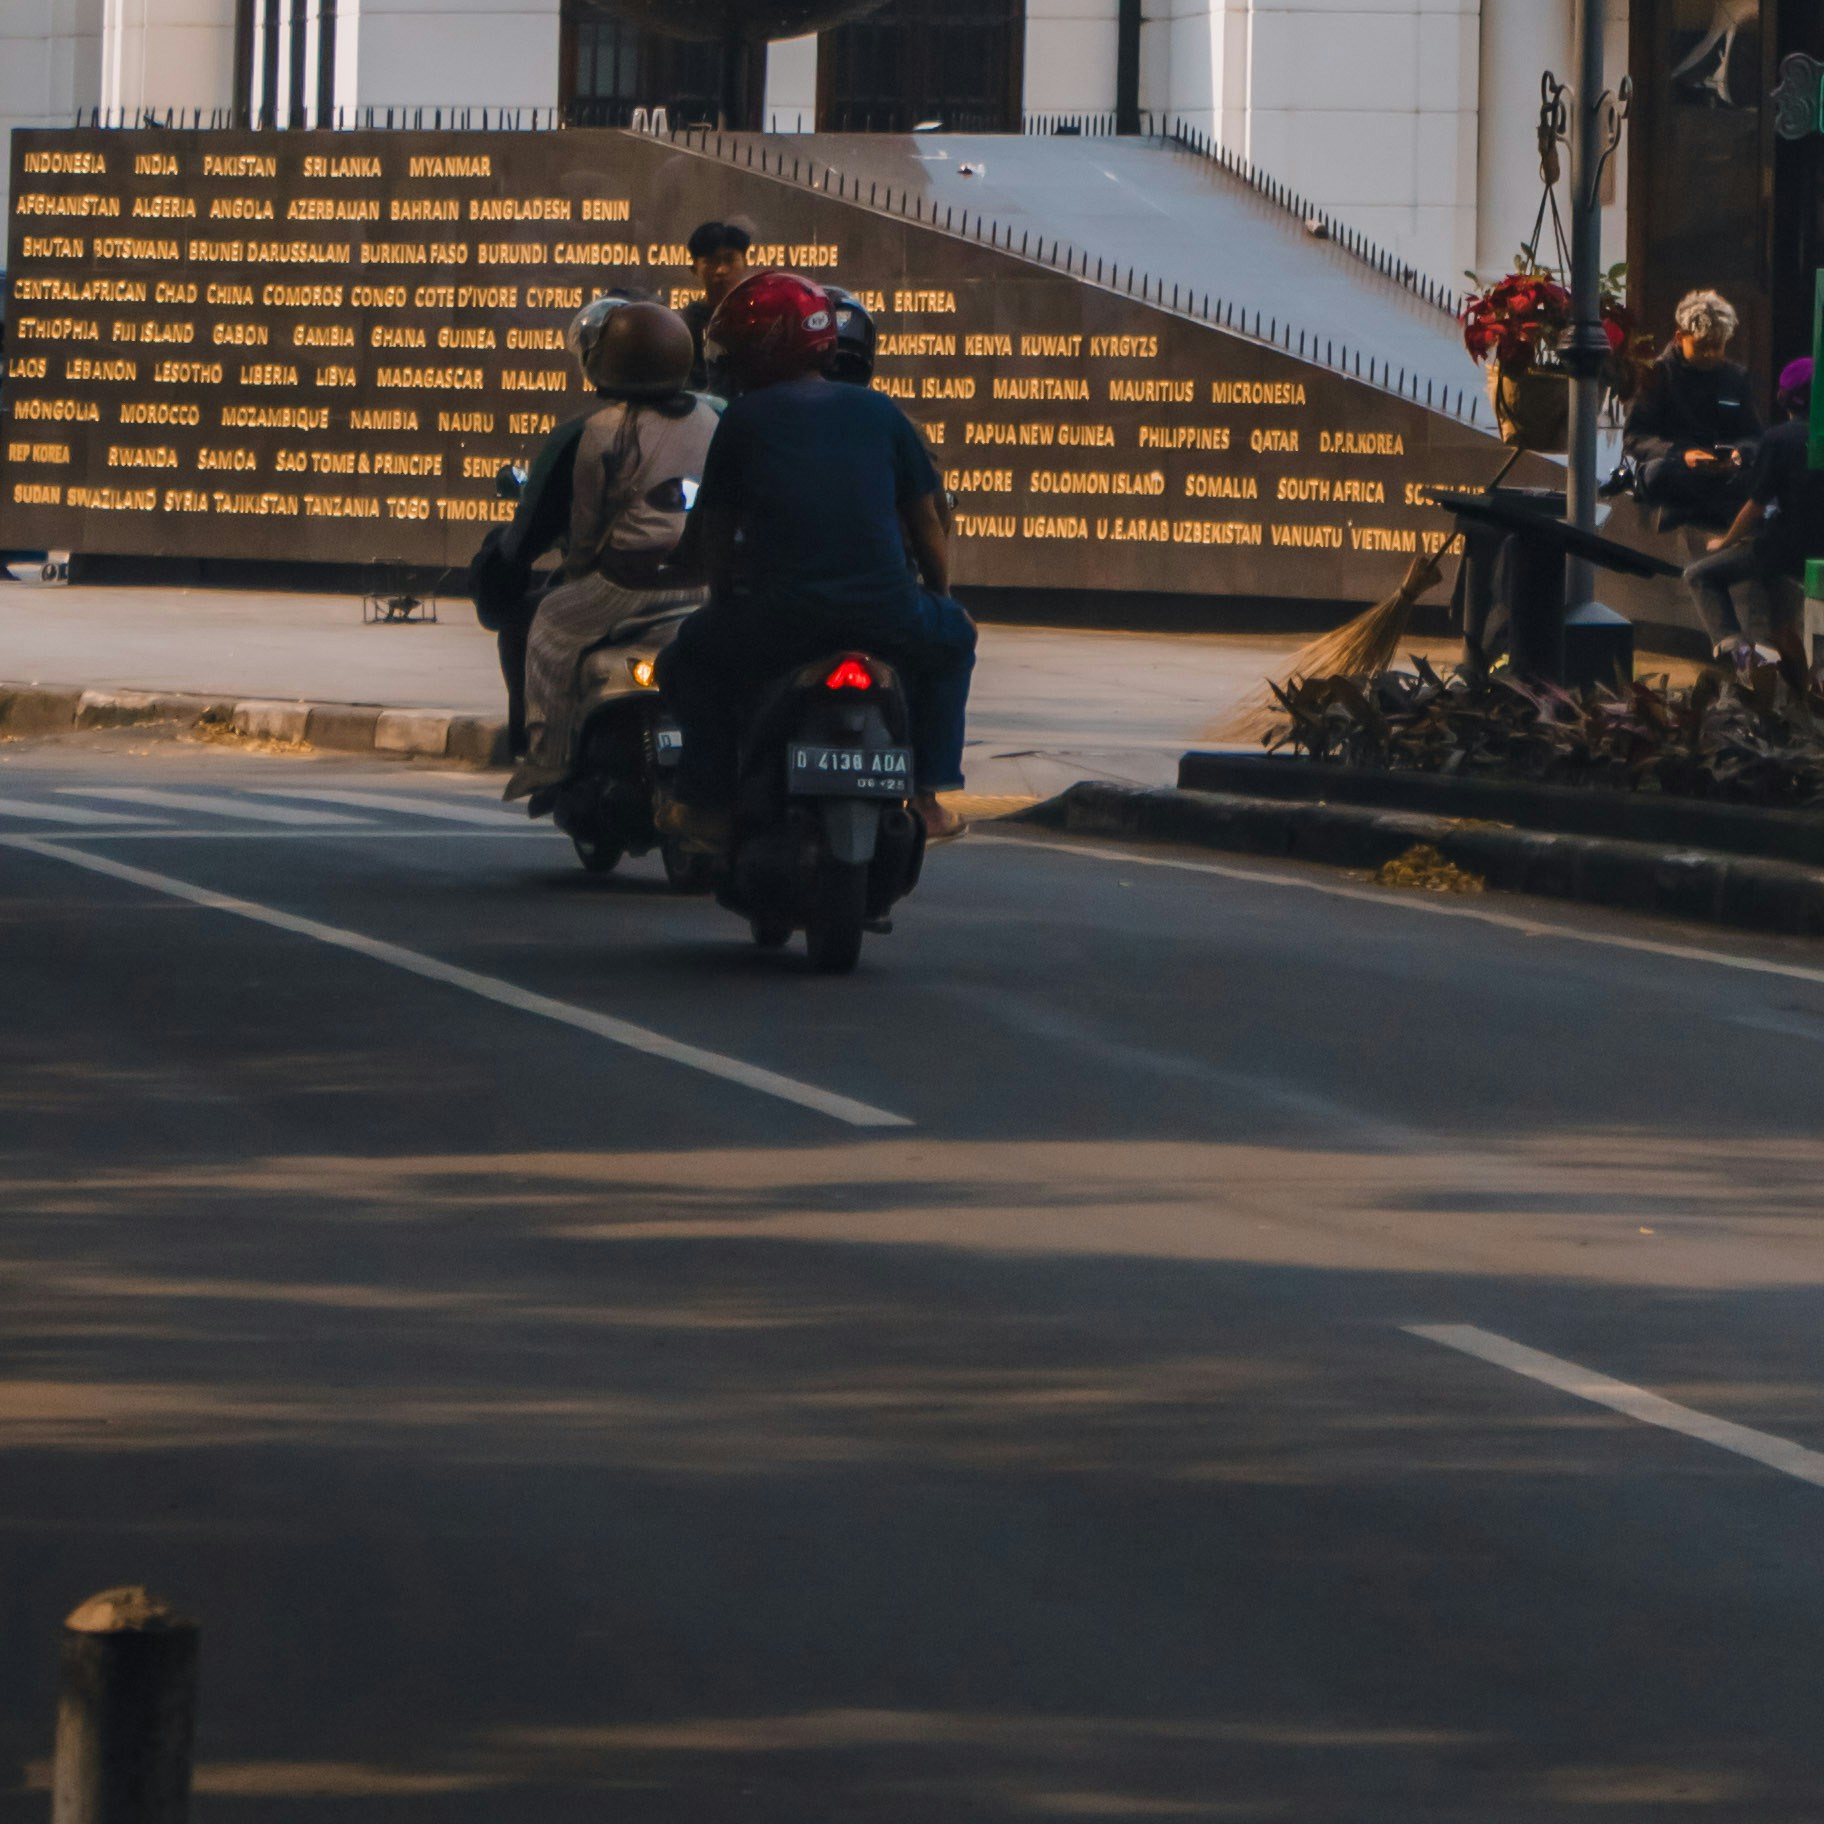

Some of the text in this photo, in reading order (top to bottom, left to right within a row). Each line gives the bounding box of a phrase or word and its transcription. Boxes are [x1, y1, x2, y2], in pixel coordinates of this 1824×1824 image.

[25, 152, 493, 178] INDONESIA INDIA PAKISTAN SRI LANKA MYANMAR
[16, 194, 631, 222] AFGHANISTAN ALGERIA ANGOLA AZERBAIJAN BAHRAIN BANGLADESH BENIN
[23, 236, 85, 259] BHUTAN
[93, 237, 181, 261] BOTSWANA
[189, 240, 245, 262] BRUNEI
[247, 241, 352, 264] DARUSSALAM
[360, 243, 428, 265] BURKINA
[430, 243, 470, 265] FASO
[478, 243, 550, 265] BURUNDI
[554, 242, 642, 266] CAMBODIA
[745, 244, 786, 268] CAPE
[789, 244, 840, 268] VERDE
[155, 281, 199, 305] CHAD
[207, 283, 256, 306] CHINA
[263, 284, 344, 307] COMOROS
[351, 286, 408, 309] CONGO
[414, 286, 457, 309] COTE
[526, 287, 584, 309] CYPRUS
[894, 290, 958, 314] ERITREA
[112, 321, 138, 343] FIJI
[140, 321, 196, 344] ISLAND
[213, 323, 270, 347] GABON
[293, 325, 356, 348] GAMBIA
[371, 326, 428, 349] GHANA
[438, 327, 498, 350] GUINEA
[507, 328, 566, 351] GUINEA
[876, 333, 958, 357] ZAKHSTAN
[965, 334, 1014, 358] KENYA
[1021, 335, 1084, 358] KUWAIT
[9, 358, 48, 379] LAOS
[66, 358, 138, 382] LEBANON
[154, 361, 224, 385] LESOTHO
[240, 364, 300, 386] LIBERIA
[316, 365, 358, 387] LIBYA
[377, 367, 485, 391] MADAGASCAR
[501, 370, 568, 392] MALAWI
[922, 377, 977, 401] ISLAND
[993, 377, 1091, 401] MAURITANIA
[1109, 380, 1196, 404] MAURITIUS
[1212, 382, 1307, 406] MICRONESIA
[15, 399, 101, 423] MONGOLIA
[120, 403, 201, 426] MOROCCO
[221, 406, 331, 431] MOZAMBIQUE
[351, 409, 420, 432] NAMIBIA
[439, 412, 495, 434] NAURU
[965, 422, 1018, 447] PAPUA
[1019, 423, 1056, 447] NEW
[1058, 424, 1116, 448] GUINEA
[1139, 426, 1232, 451] PHILIPPINES
[1251, 429, 1300, 454] QATAR
[108, 446, 180, 469] RWANDA
[197, 448, 258, 471] SAMOA
[275, 450, 309, 473] SAO
[311, 452, 357, 475] TOME
[374, 453, 444, 477] PRINCIPE
[1030, 471, 1110, 496] SOLOMON
[1111, 470, 1167, 497] ISLAND
[1185, 474, 1259, 500] SOMALIA
[1277, 477, 1332, 502] SOUTH
[1333, 480, 1386, 504] AFRICA
[14, 484, 63, 506] SUDAN
[67, 487, 158, 511] SWAZILAND
[164, 490, 210, 513] SYRIA
[213, 491, 300, 516] TAJIKISTAN
[304, 494, 381, 519] TANZANIA
[386, 496, 432, 521] TOGO
[436, 498, 489, 522] TIMOR
[954, 514, 1018, 539] TUVALU
[1023, 516, 1090, 541] UGANDA
[1173, 520, 1264, 546] UZBEKISTAN
[1271, 524, 1344, 550] VANUATU
[1351, 527, 1418, 554] VIETNAM
[796, 749, 808, 769] D
[871, 753, 908, 774] ADA
